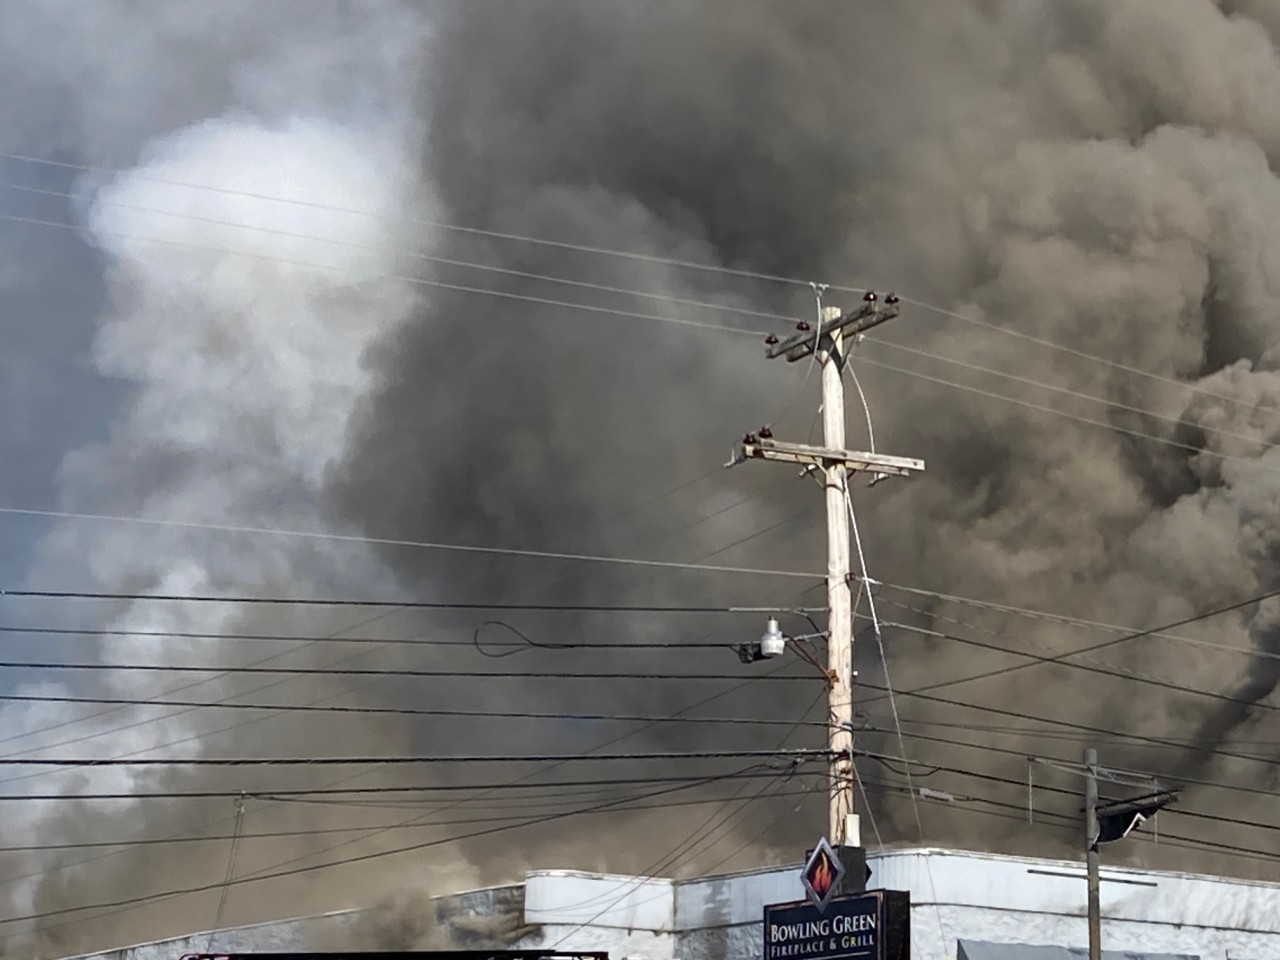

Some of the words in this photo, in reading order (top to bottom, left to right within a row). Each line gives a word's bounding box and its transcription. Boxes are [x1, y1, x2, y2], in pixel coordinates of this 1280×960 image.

[771, 920, 829, 942] BOWLING
[833, 914, 876, 934] GREEN
[772, 942, 824, 958] FIREPLACE
[830, 938, 837, 949] &
[842, 936, 874, 949] GRILL
